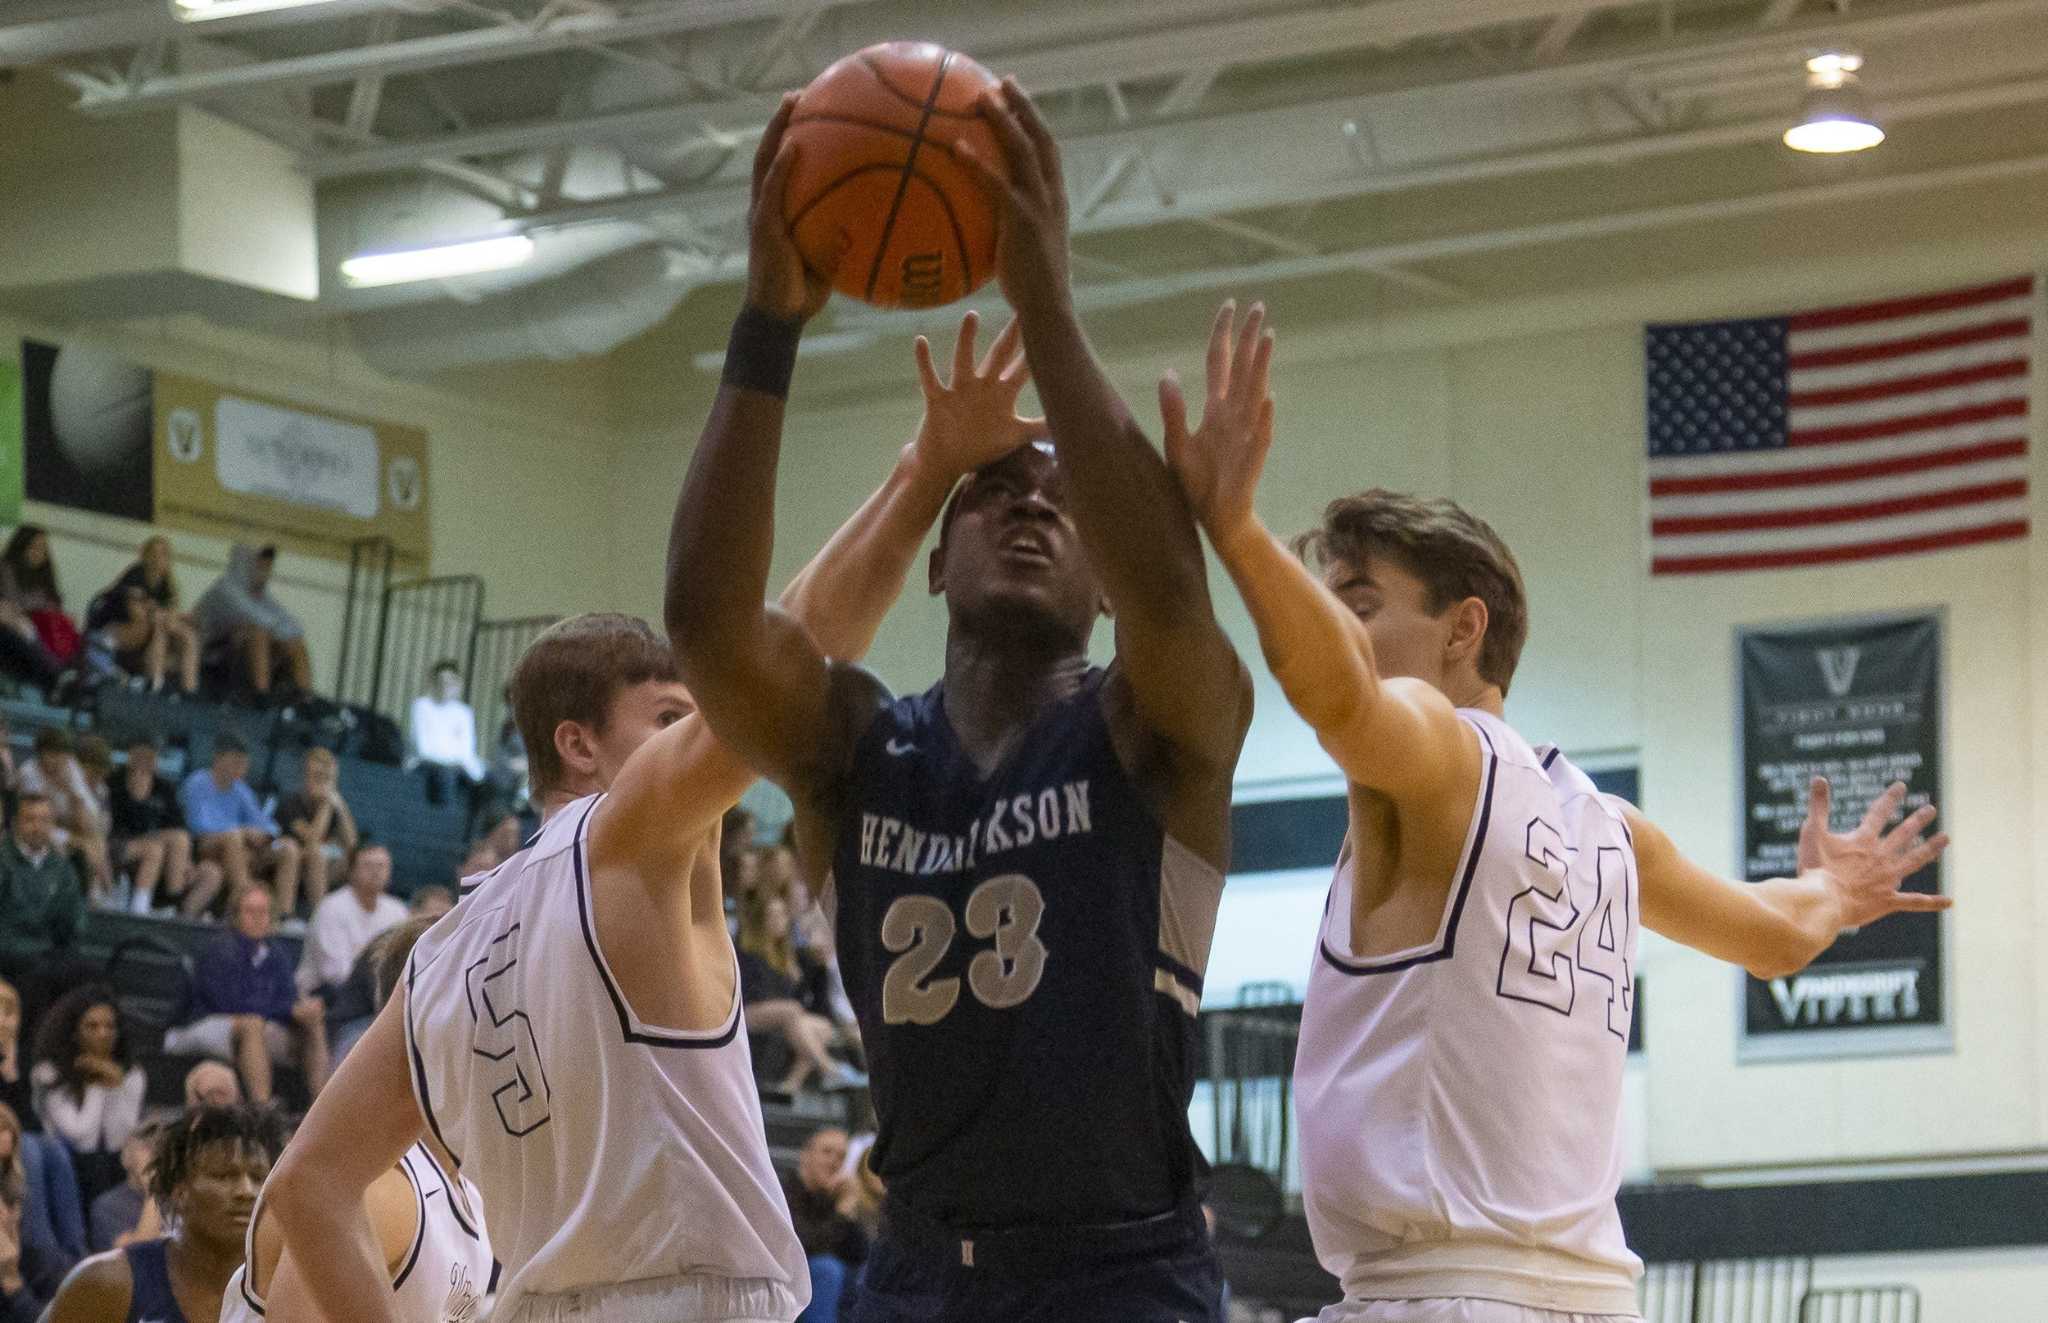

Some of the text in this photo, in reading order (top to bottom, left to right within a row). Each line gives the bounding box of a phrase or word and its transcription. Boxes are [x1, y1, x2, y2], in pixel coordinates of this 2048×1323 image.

[1816, 646, 1859, 696] V
[881, 874, 1049, 1025] 23
[1497, 816, 1631, 1042] 24
[466, 922, 551, 1137] 5
